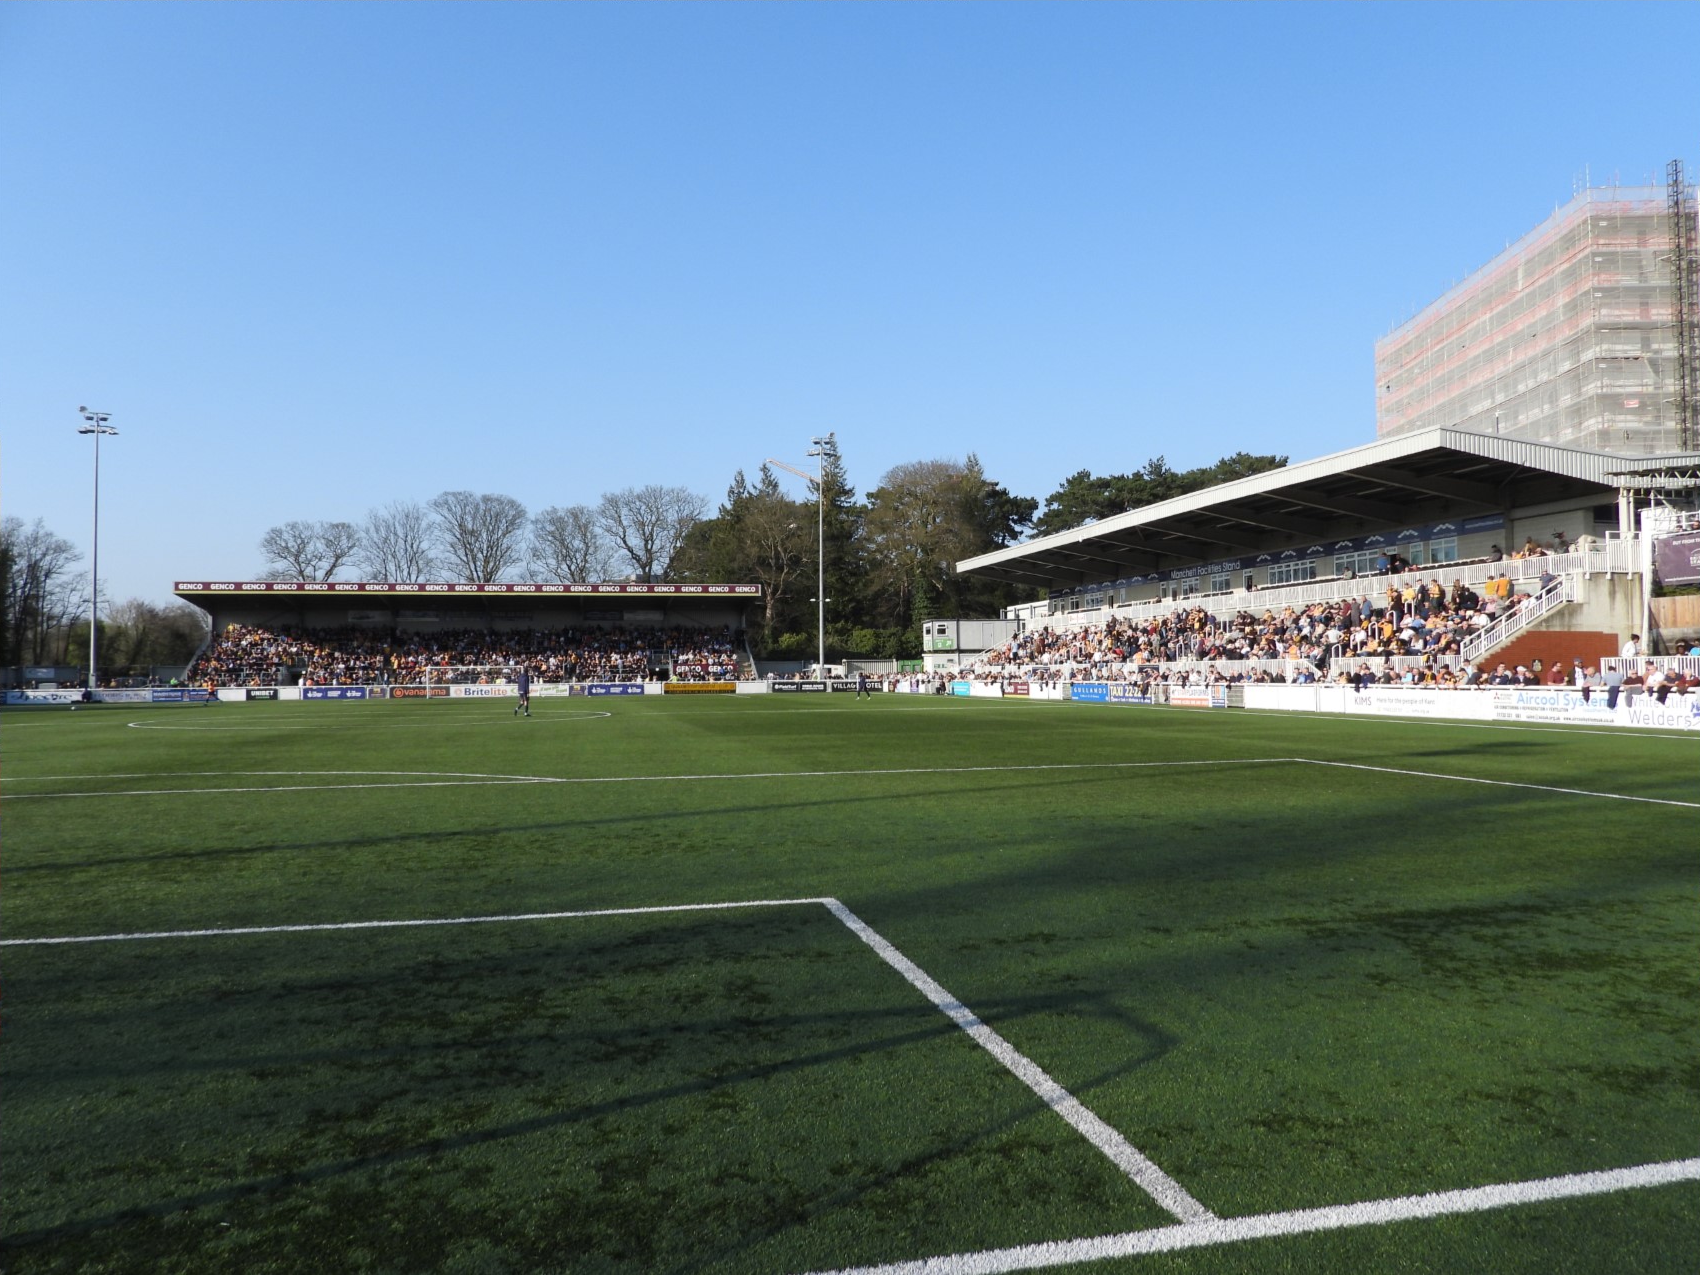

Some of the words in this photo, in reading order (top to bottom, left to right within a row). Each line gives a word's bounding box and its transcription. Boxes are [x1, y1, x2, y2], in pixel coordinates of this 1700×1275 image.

[1171, 568, 1197, 579] Manchett
[1197, 565, 1221, 576] Facilities
[1222, 560, 1240, 571] Stand
[464, 687, 507, 696] Britelite
[1354, 696, 1372, 706] KIMS
[1516, 692, 1559, 706] Aircool
[1628, 709, 1692, 727] Welders
